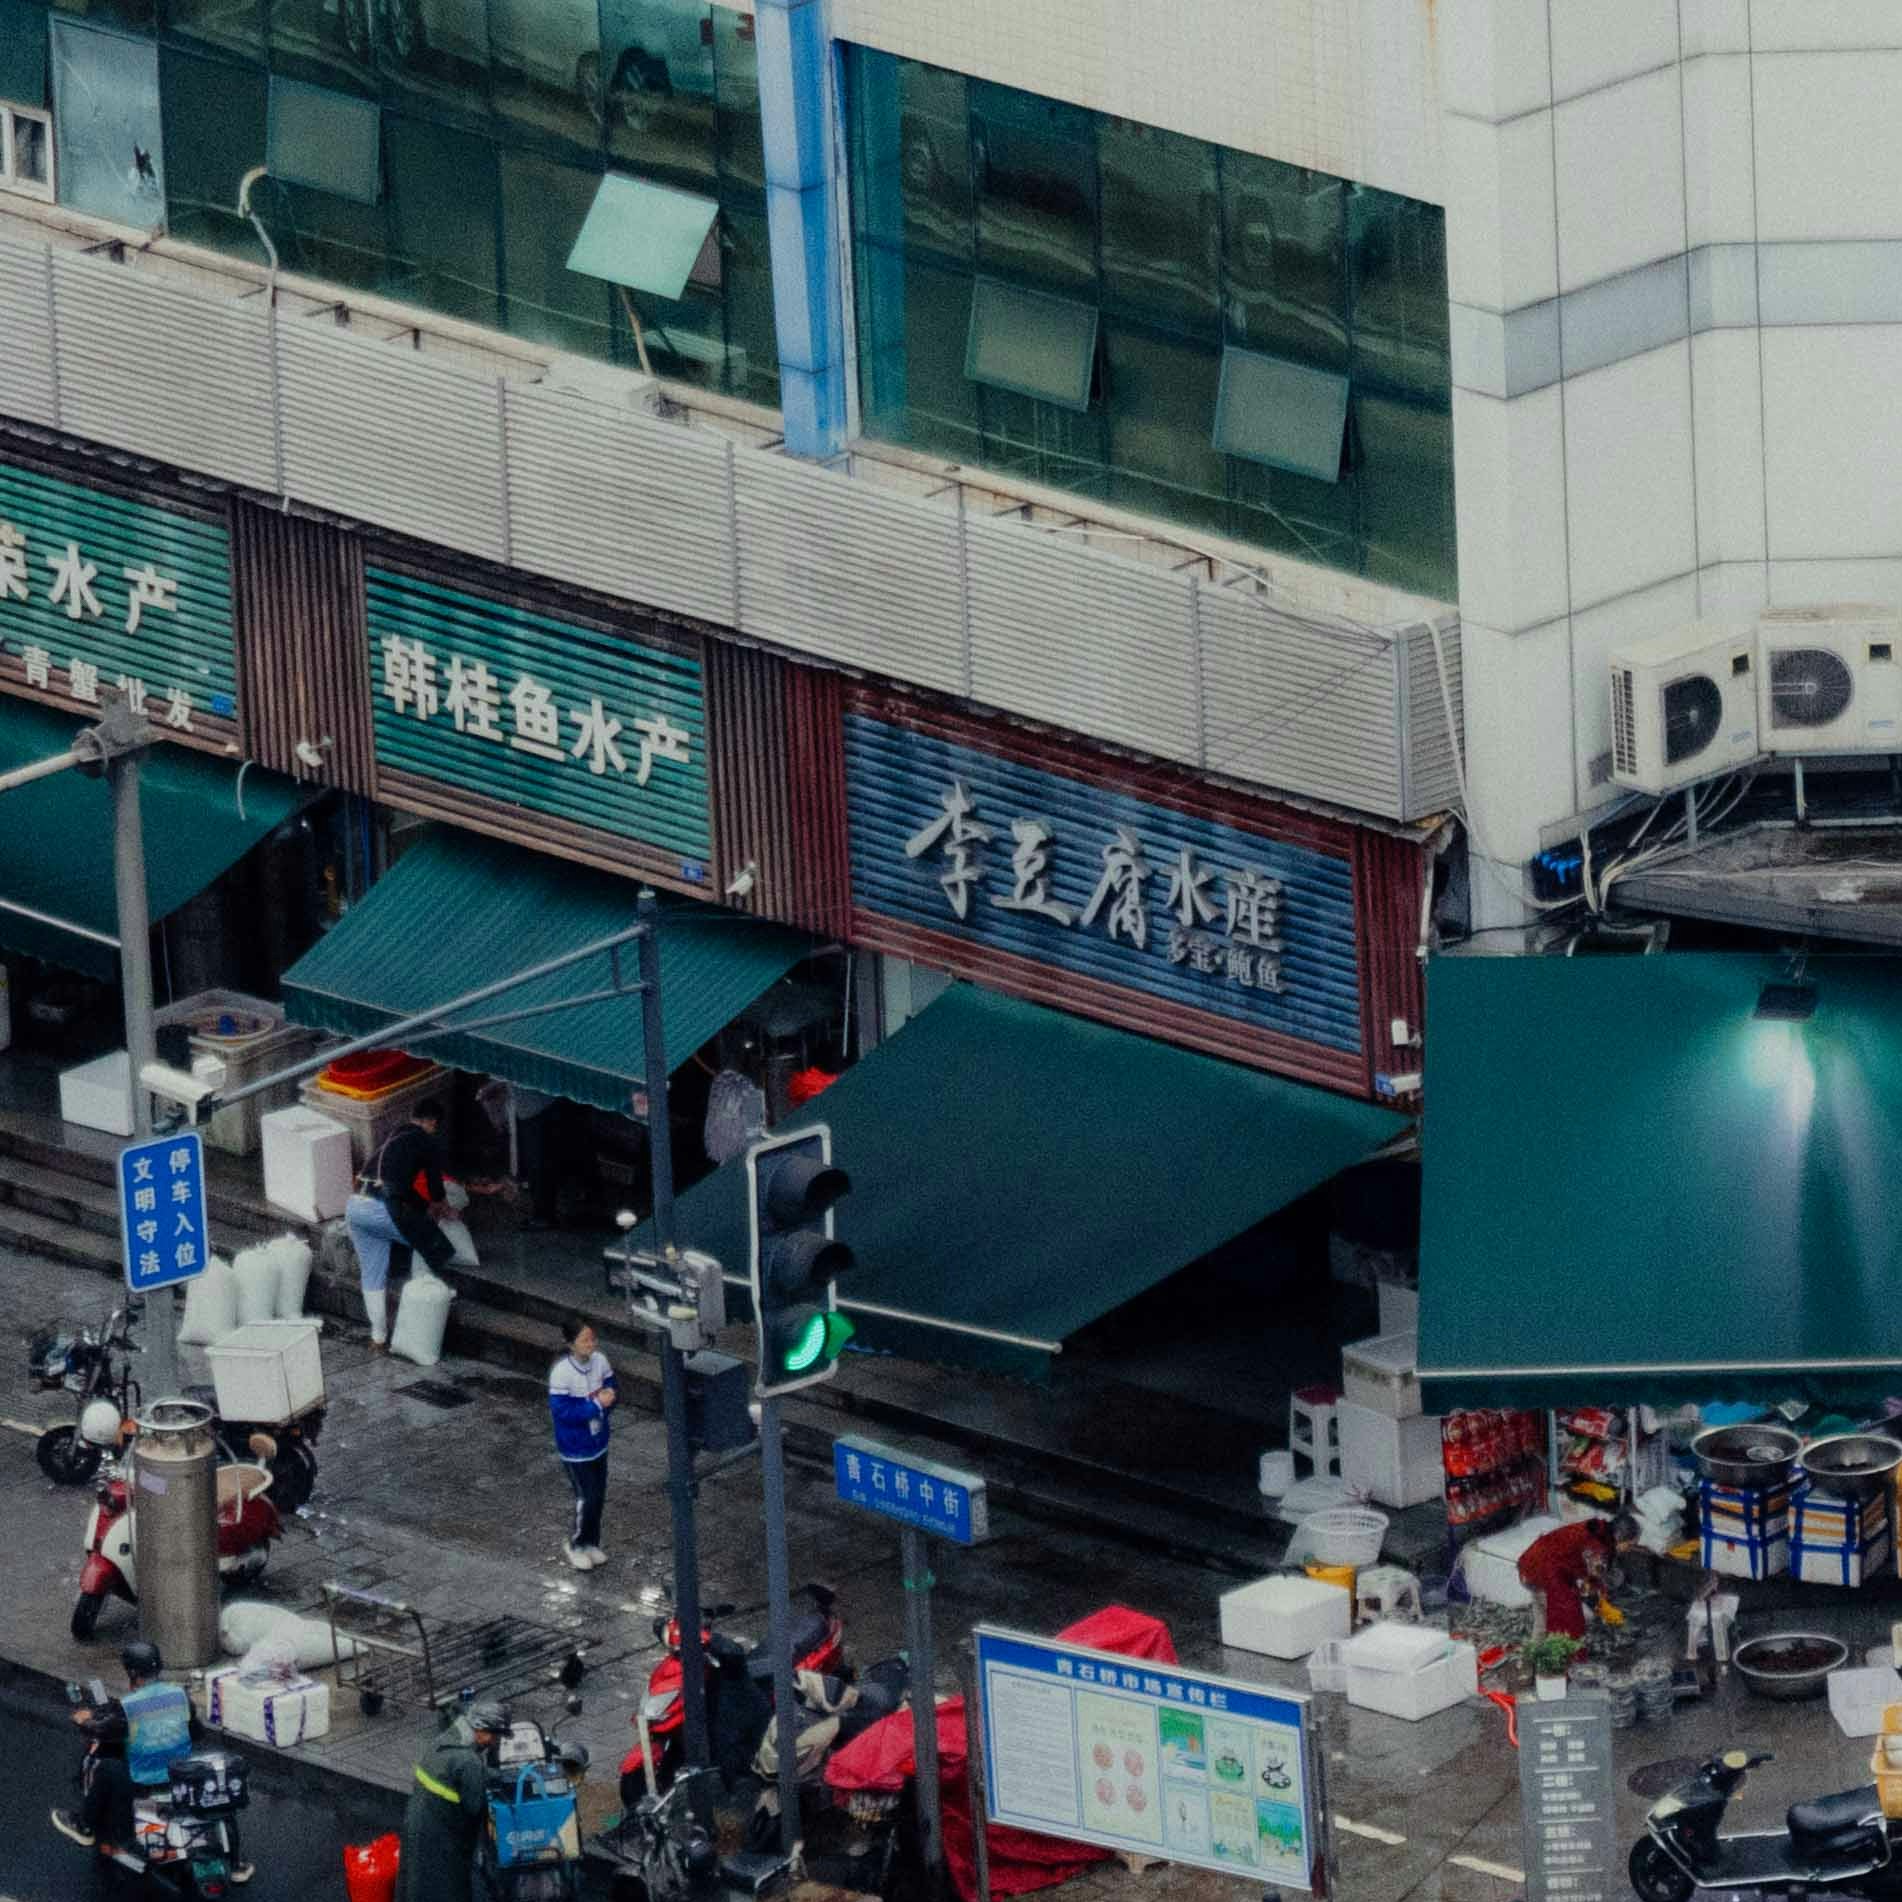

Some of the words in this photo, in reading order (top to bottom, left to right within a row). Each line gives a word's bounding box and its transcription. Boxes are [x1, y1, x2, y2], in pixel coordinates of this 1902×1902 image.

[381, 632, 690, 787] 韩桂鱼水产
[132, 1156, 161, 1276] 文明守法
[169, 1147, 197, 1269] 停车入位
[846, 1453, 960, 1518] 青石桥中街
